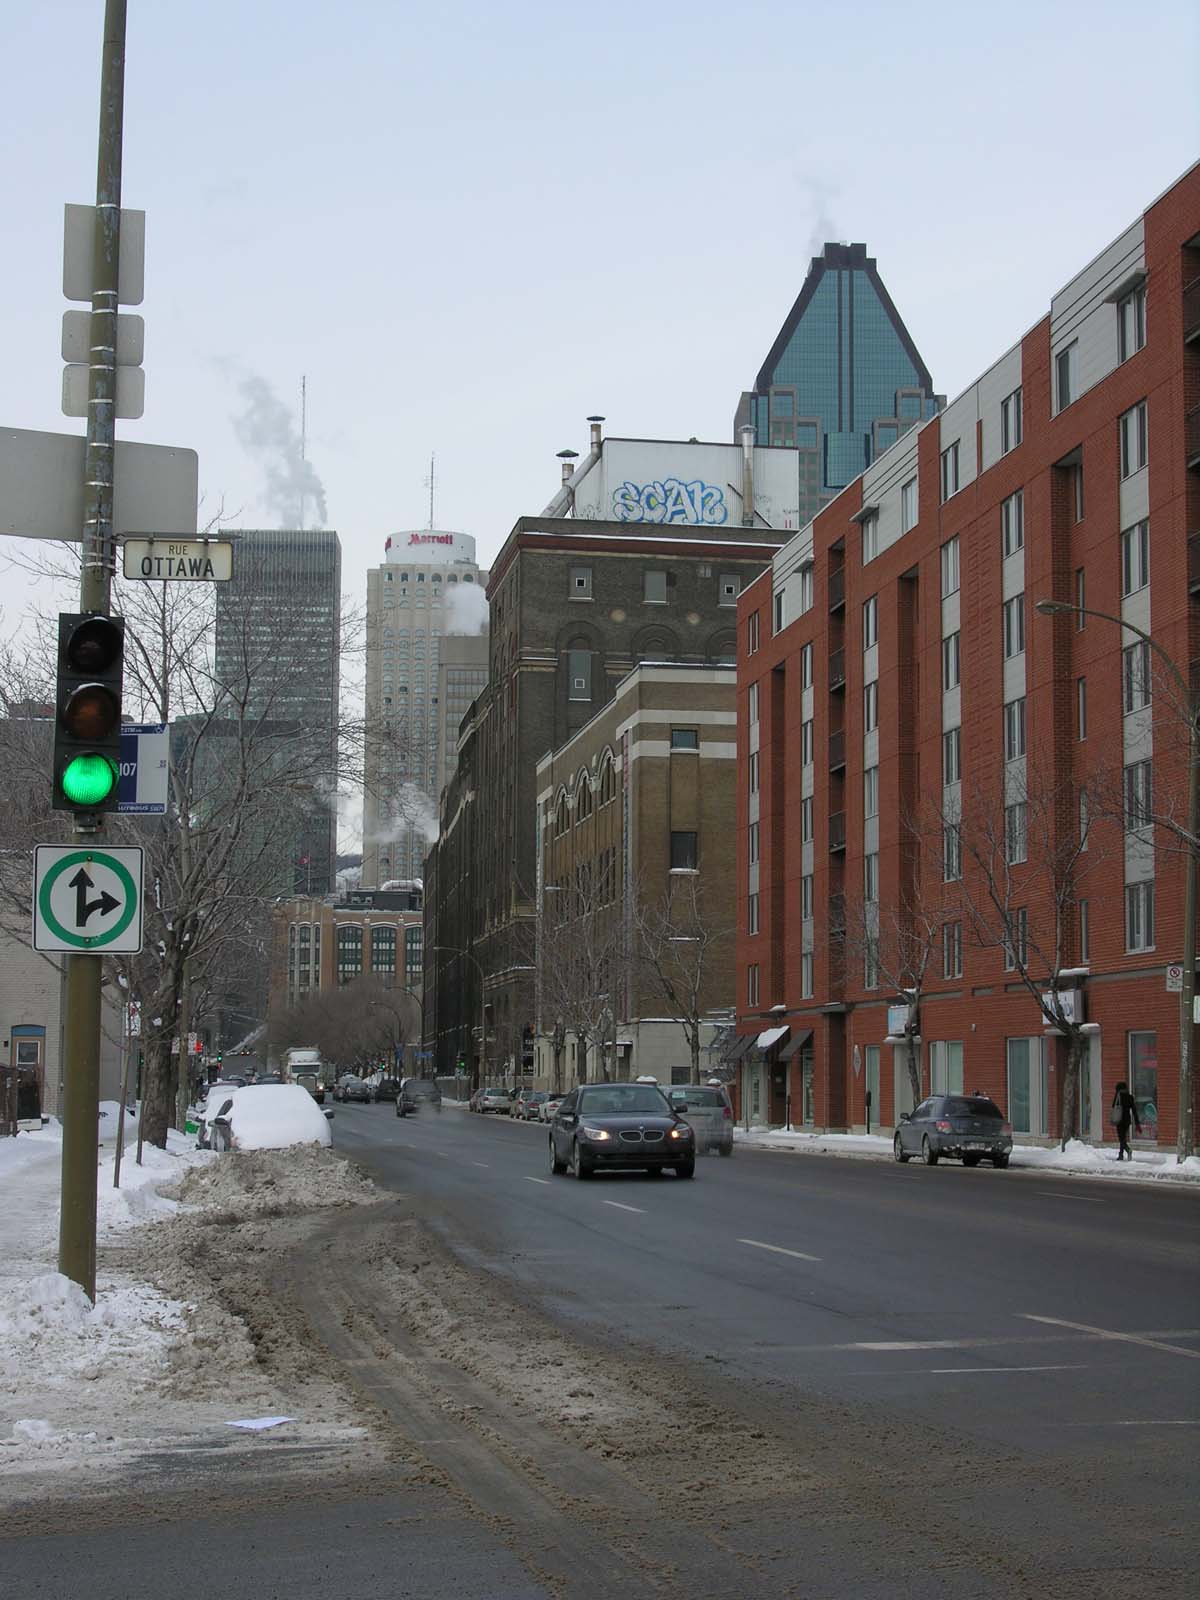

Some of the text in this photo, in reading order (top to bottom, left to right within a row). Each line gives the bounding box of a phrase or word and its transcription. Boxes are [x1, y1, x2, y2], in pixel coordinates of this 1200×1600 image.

[168, 545, 188, 555] RUE
[141, 556, 215, 577] OTTAWA
[119, 762, 137, 777] 107
